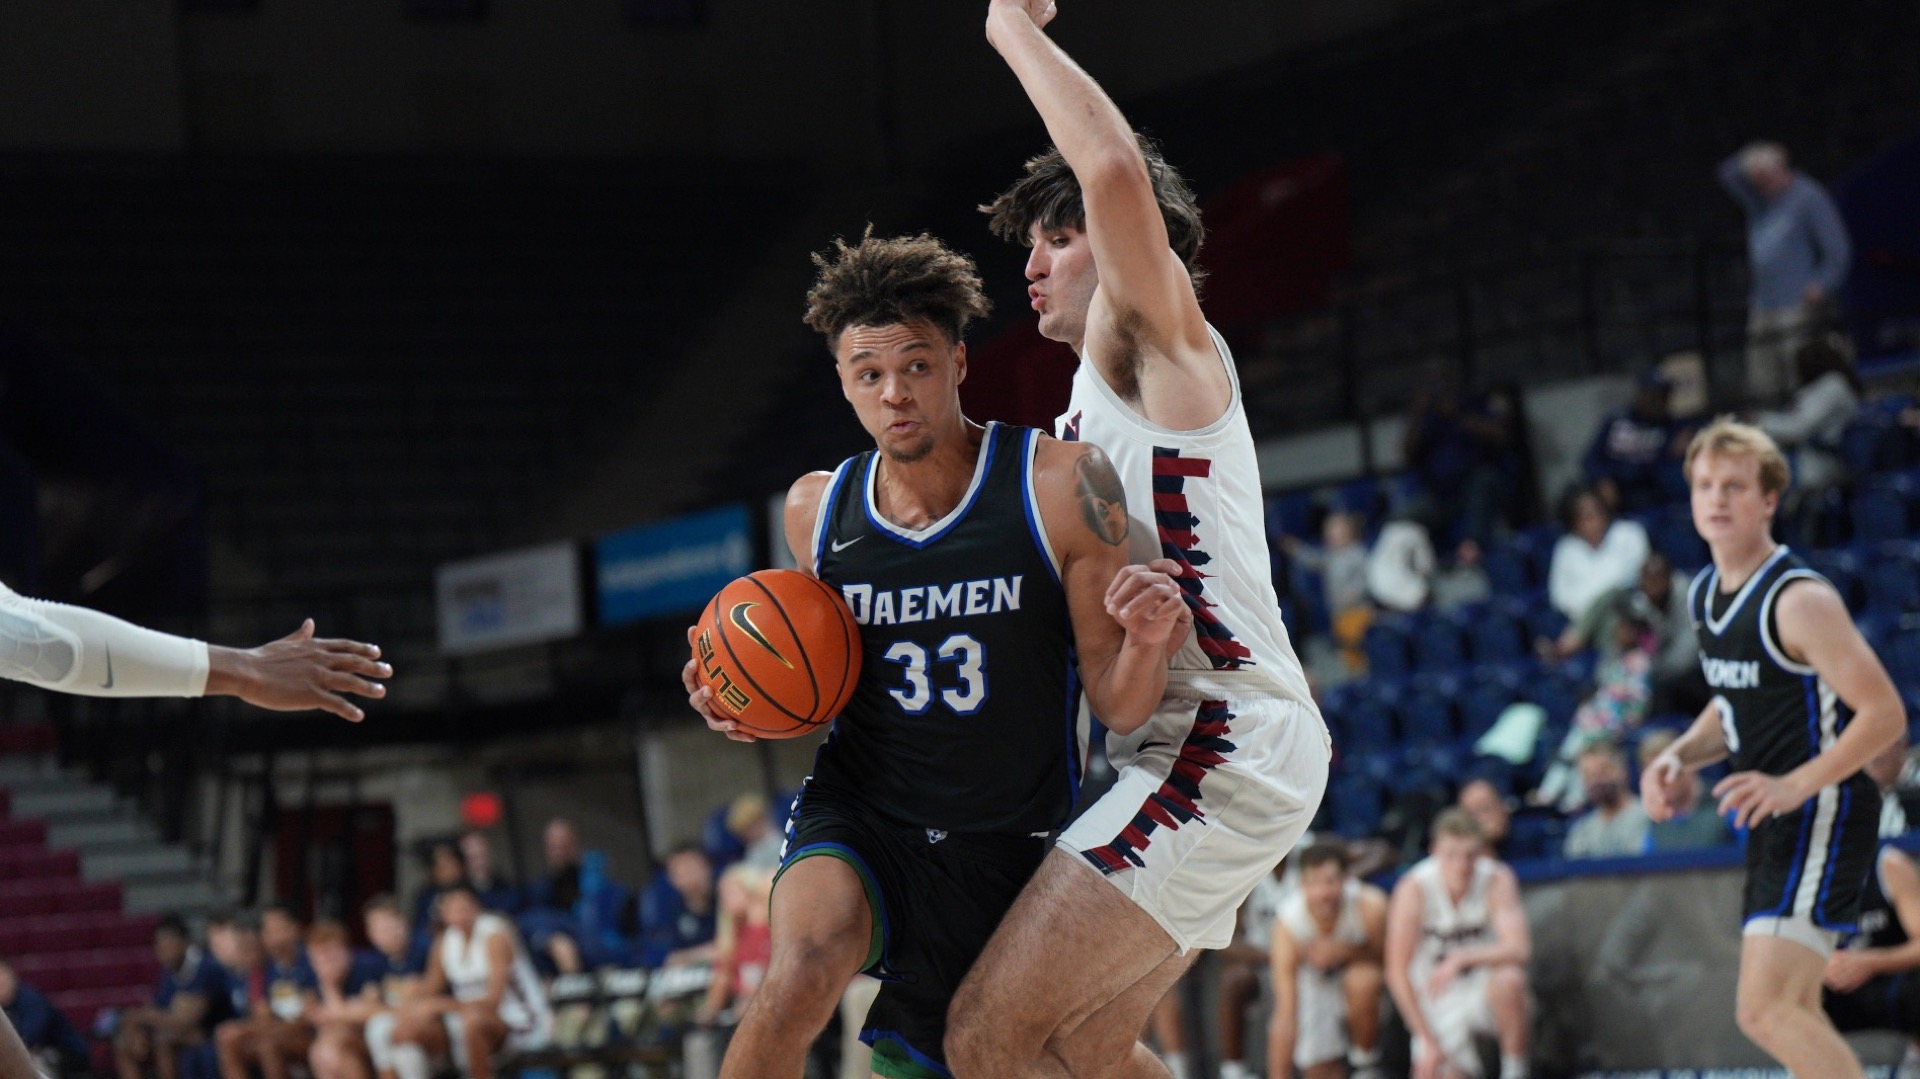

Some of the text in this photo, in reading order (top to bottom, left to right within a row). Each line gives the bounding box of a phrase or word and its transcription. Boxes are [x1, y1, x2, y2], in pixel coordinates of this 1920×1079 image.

[842, 575, 1024, 626] DAEMEN
[697, 627, 752, 713] ELITE
[884, 633, 990, 716] 33
